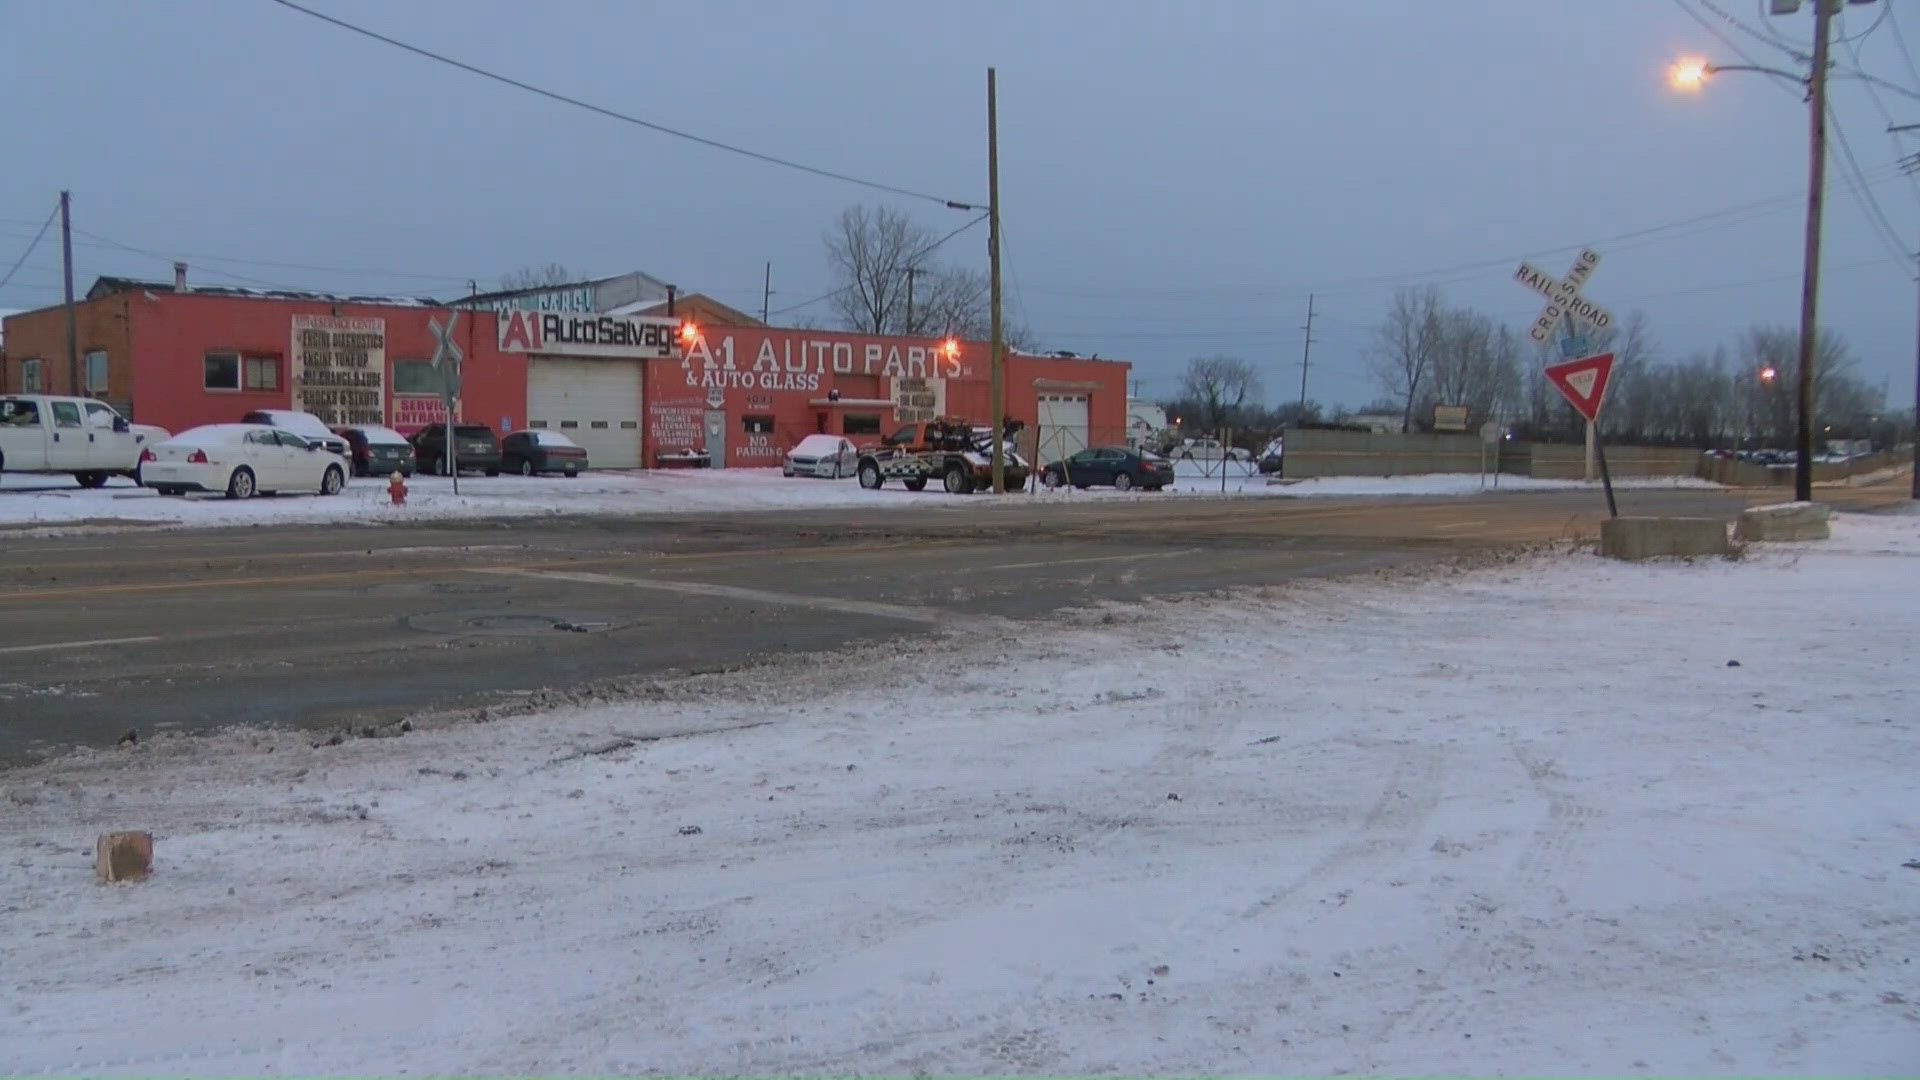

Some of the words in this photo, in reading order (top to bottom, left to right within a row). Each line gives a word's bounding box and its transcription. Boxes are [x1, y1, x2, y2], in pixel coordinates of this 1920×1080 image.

[1531, 250, 1596, 341] CROSSING
[352, 320, 382, 330] CENTER
[502, 310, 543, 349] A1
[303, 331, 330, 348] ENGINE
[333, 333, 384, 349] DIAGNOSTICS
[303, 351, 332, 367] ENGINE
[335, 352, 355, 367] TUNE
[358, 352, 369, 368] UP
[753, 338, 852, 374] AUTO
[864, 343, 963, 378] PARTS
[320, 371, 351, 387] CHANGE
[686, 374, 698, 387] &
[701, 370, 755, 388] AUTO
[760, 372, 820, 391] GLASS
[303, 390, 337, 405] SHOCKS
[348, 391, 379, 406] STRUTS
[401, 399, 453, 411] SERVIC
[349, 410, 383, 425] COOLING
[649, 407, 704, 416] TRANSMISSIONS
[660, 415, 692, 423] ENGINES
[651, 422, 701, 430] ALTERNATORS
[659, 437, 694, 446] STARTERS
[749, 436, 768, 447] NO
[735, 447, 783, 457] PARKING
